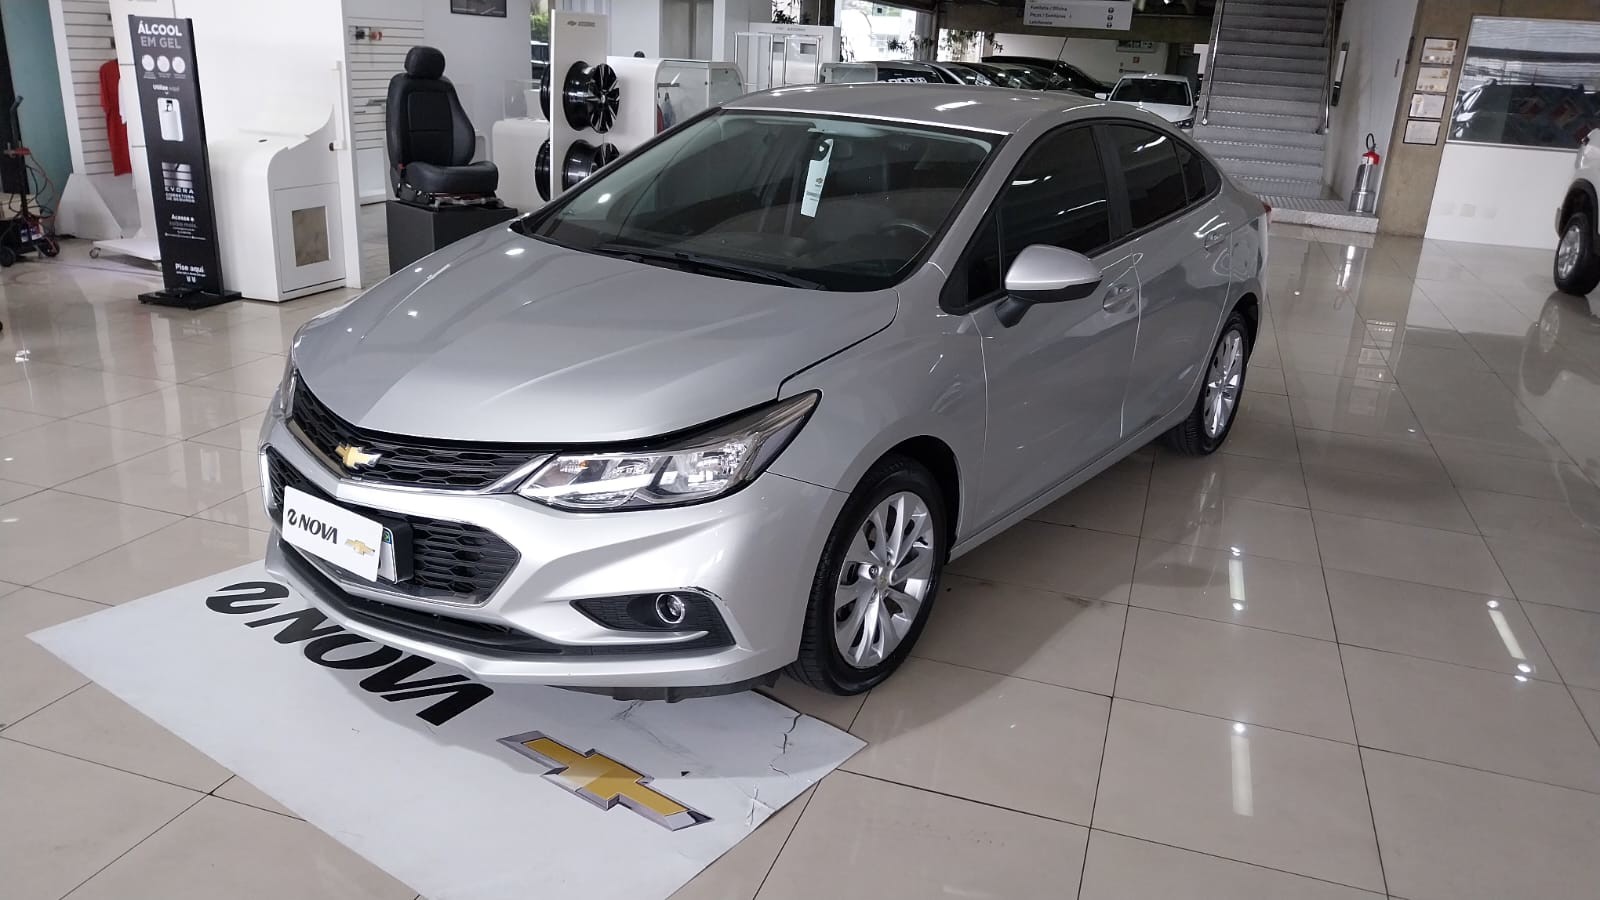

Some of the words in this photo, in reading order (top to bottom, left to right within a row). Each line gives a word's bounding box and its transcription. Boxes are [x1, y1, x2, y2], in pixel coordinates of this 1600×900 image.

[138, 20, 182, 36] ÁLCOOL
[141, 36, 156, 47] EM
[159, 37, 181, 49] GEL
[165, 186, 194, 194] EVORA
[175, 262, 189, 271] Pise
[298, 514, 338, 544] NOVA
[244, 607, 494, 726] NOVA
